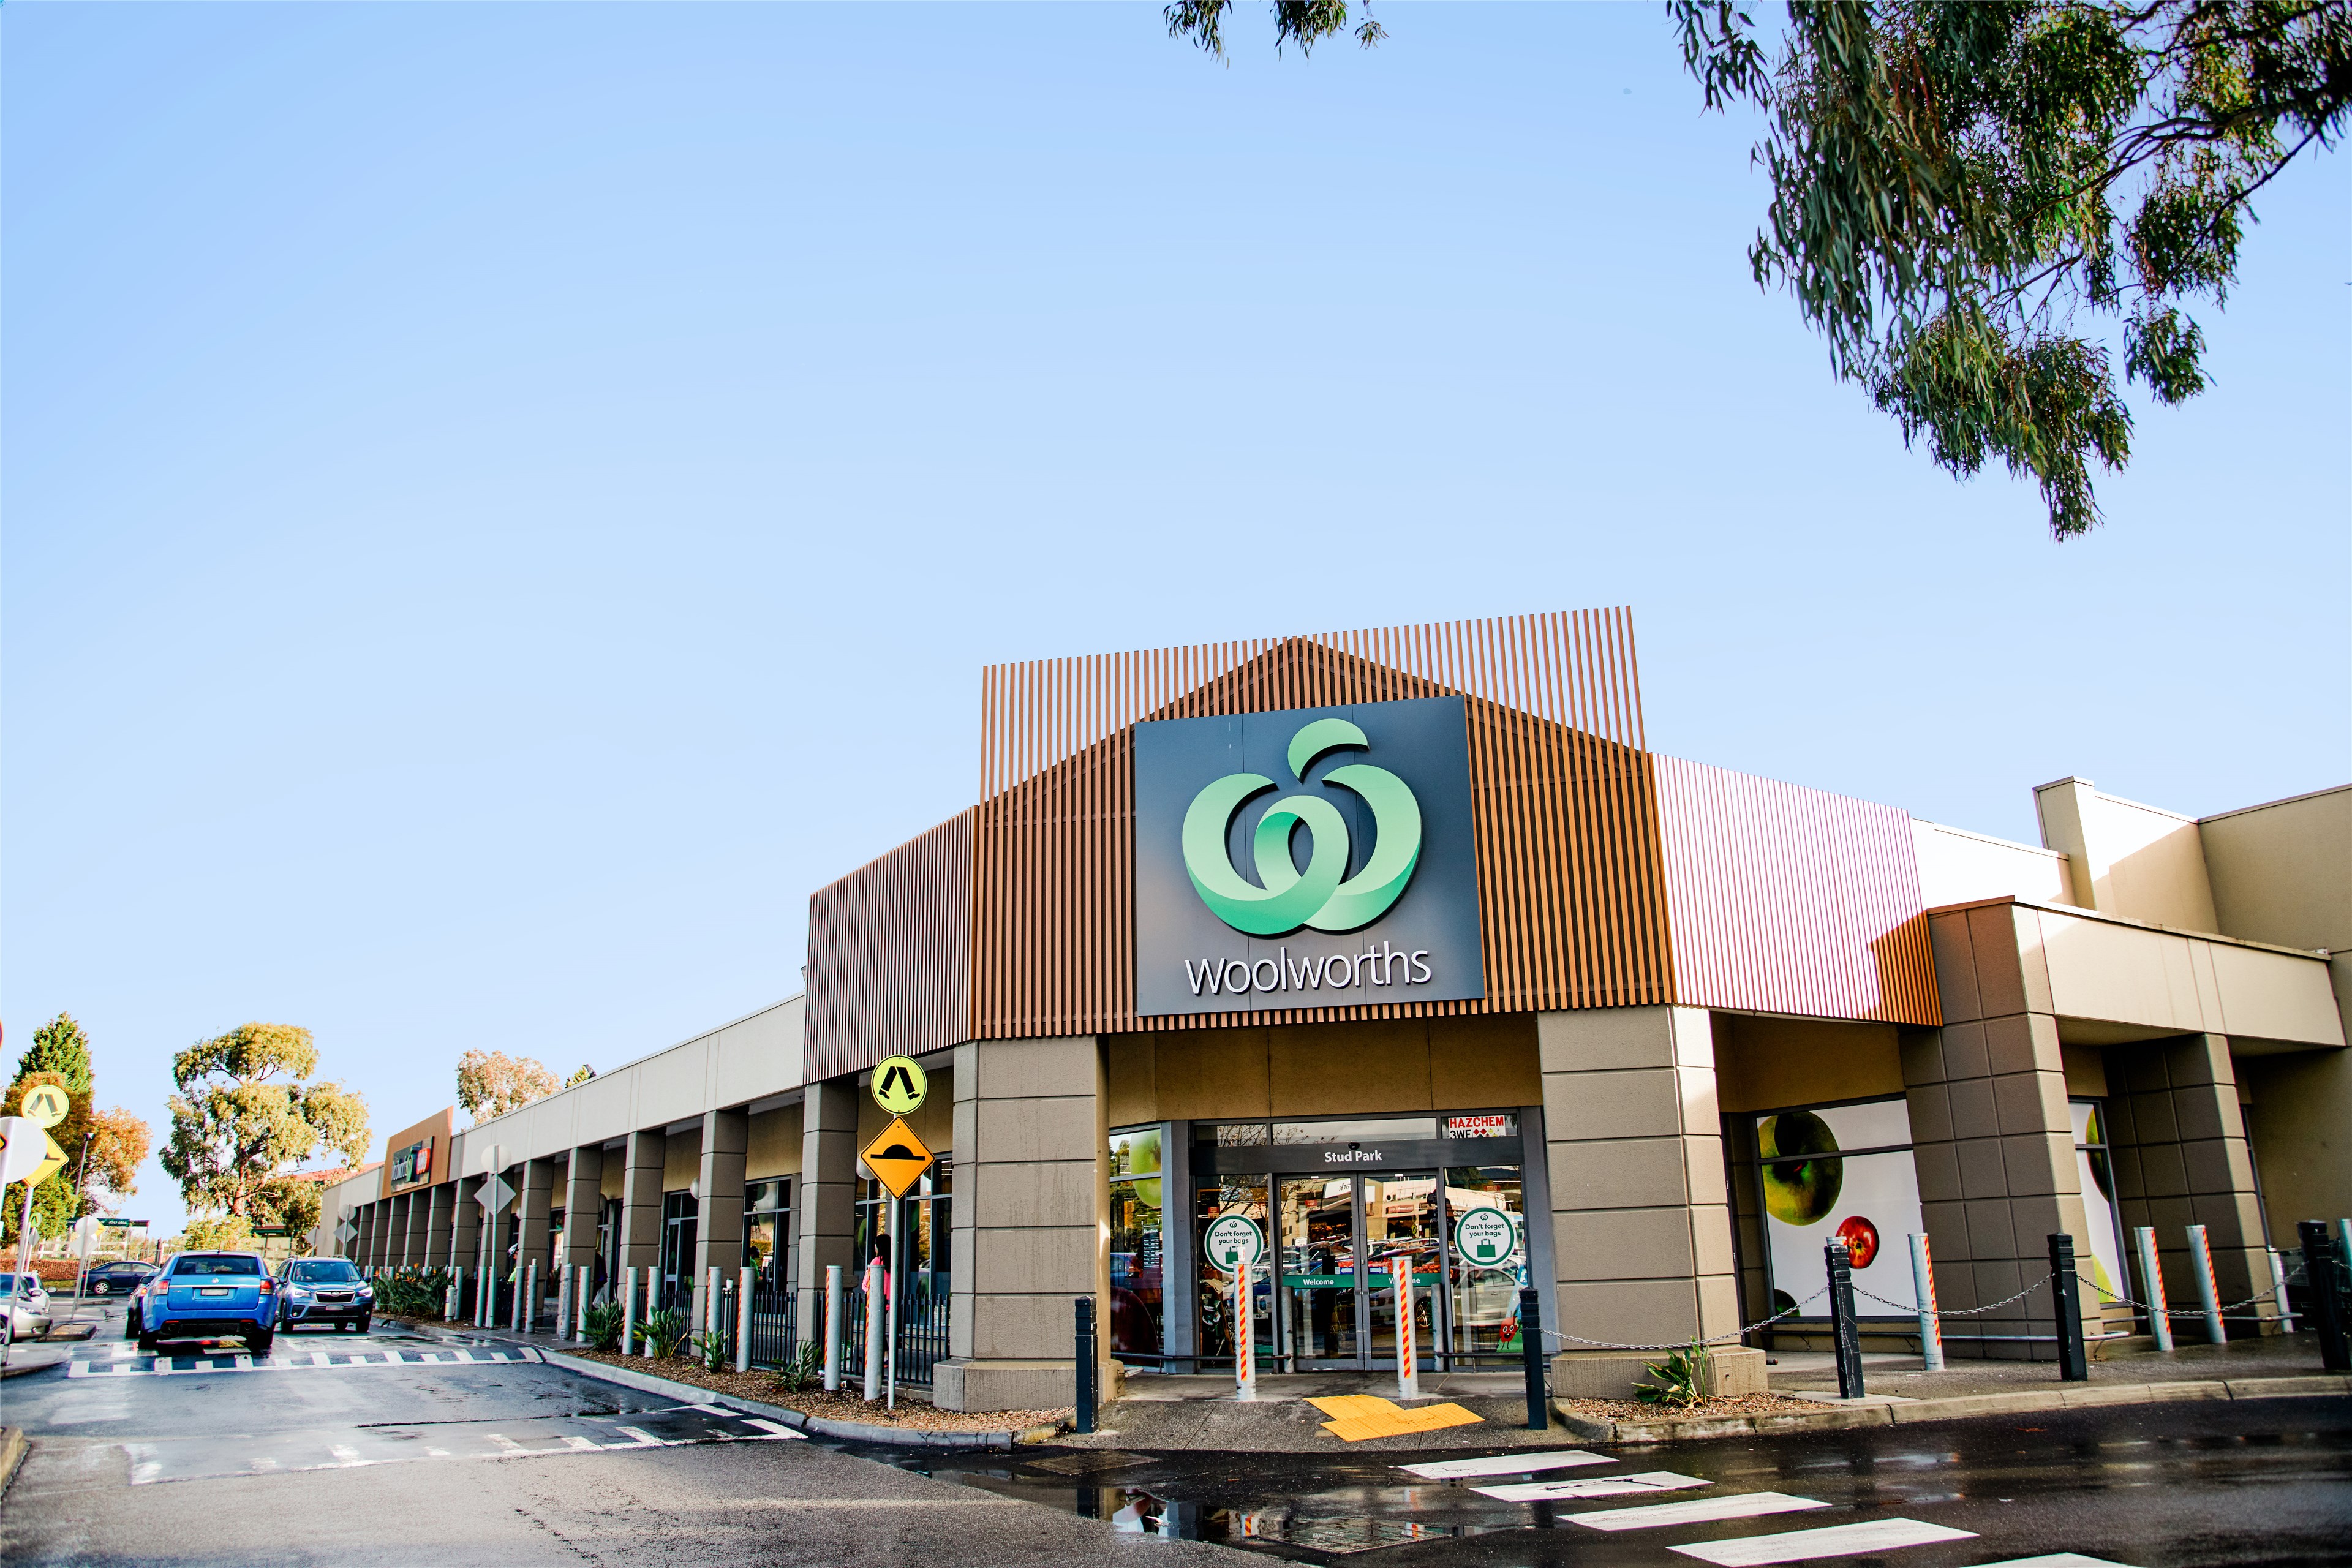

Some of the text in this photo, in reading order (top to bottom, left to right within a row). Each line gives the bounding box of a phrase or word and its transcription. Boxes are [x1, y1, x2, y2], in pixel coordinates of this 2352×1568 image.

[1185, 940, 1431, 996] Woolworths
[1449, 1116, 1504, 1128] HAZCHEM
[1325, 1150, 1382, 1163] Stud Park
